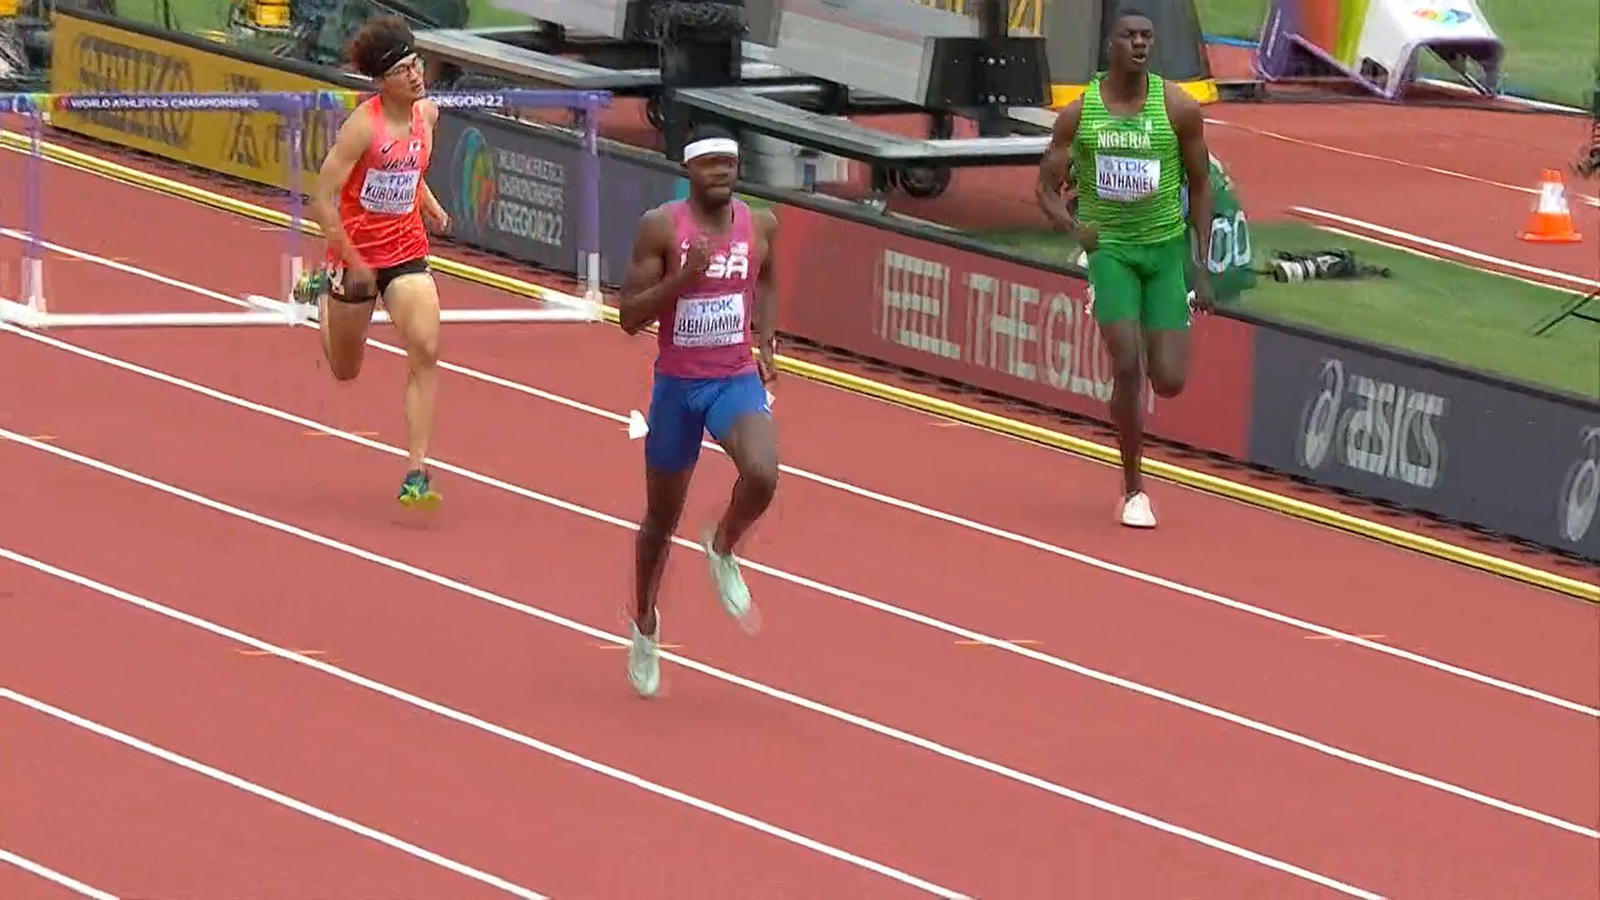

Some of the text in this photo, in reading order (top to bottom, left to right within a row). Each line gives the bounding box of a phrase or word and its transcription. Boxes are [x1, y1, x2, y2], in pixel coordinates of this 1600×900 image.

[70, 98, 110, 109] WORLD
[111, 98, 168, 109] ATHLETICS
[1097, 130, 1152, 149] NIGERIA
[1113, 160, 1150, 174] TDK
[1099, 171, 1155, 193] NATHANIEL
[698, 299, 734, 313] TDK
[678, 315, 741, 334] BENJAMIN
[964, 272, 1041, 383] THE
[1342, 374, 1446, 488] asics
